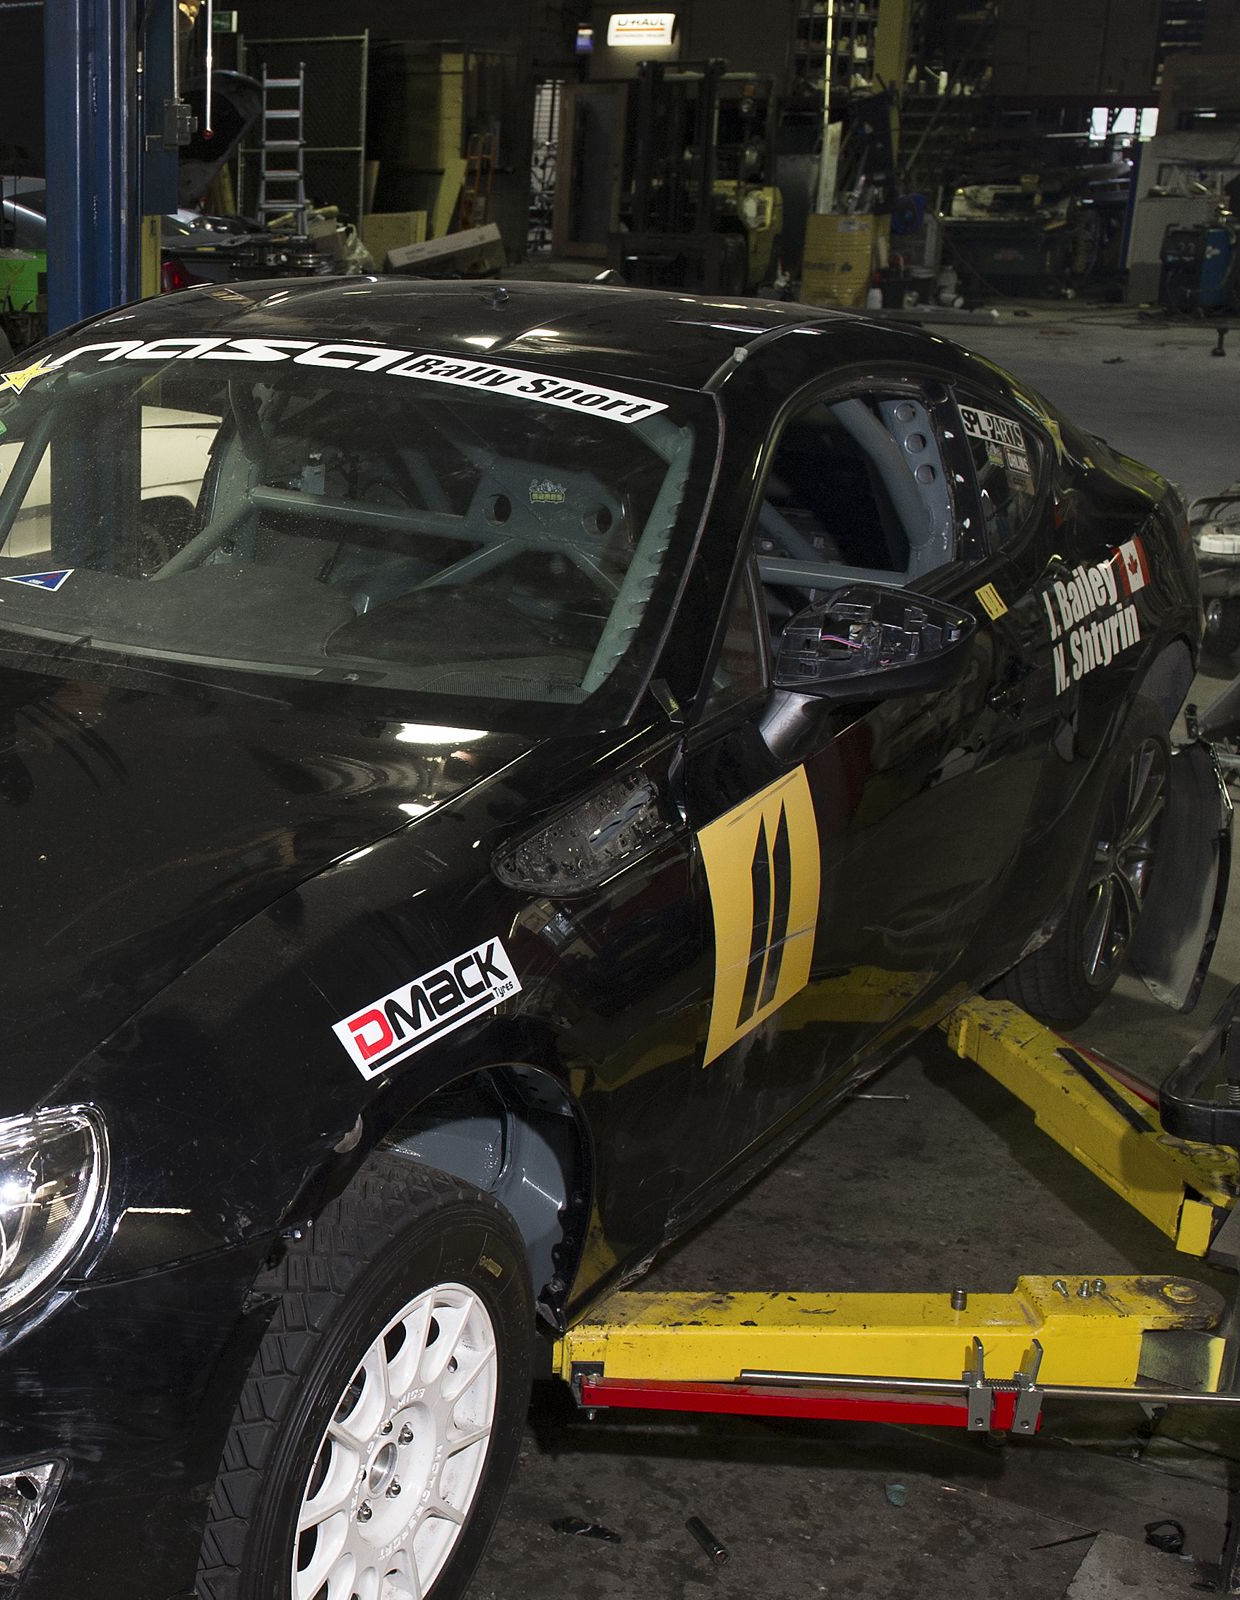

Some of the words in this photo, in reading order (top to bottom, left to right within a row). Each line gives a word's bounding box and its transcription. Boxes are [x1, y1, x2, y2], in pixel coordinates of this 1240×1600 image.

[403, 357, 517, 387] Rally
[517, 378, 652, 418] Sport
[1042, 590, 1061, 641] J.
[1053, 559, 1118, 631] Bailey
[1053, 643, 1071, 696] N.
[1070, 603, 1141, 681] Shtyrin
